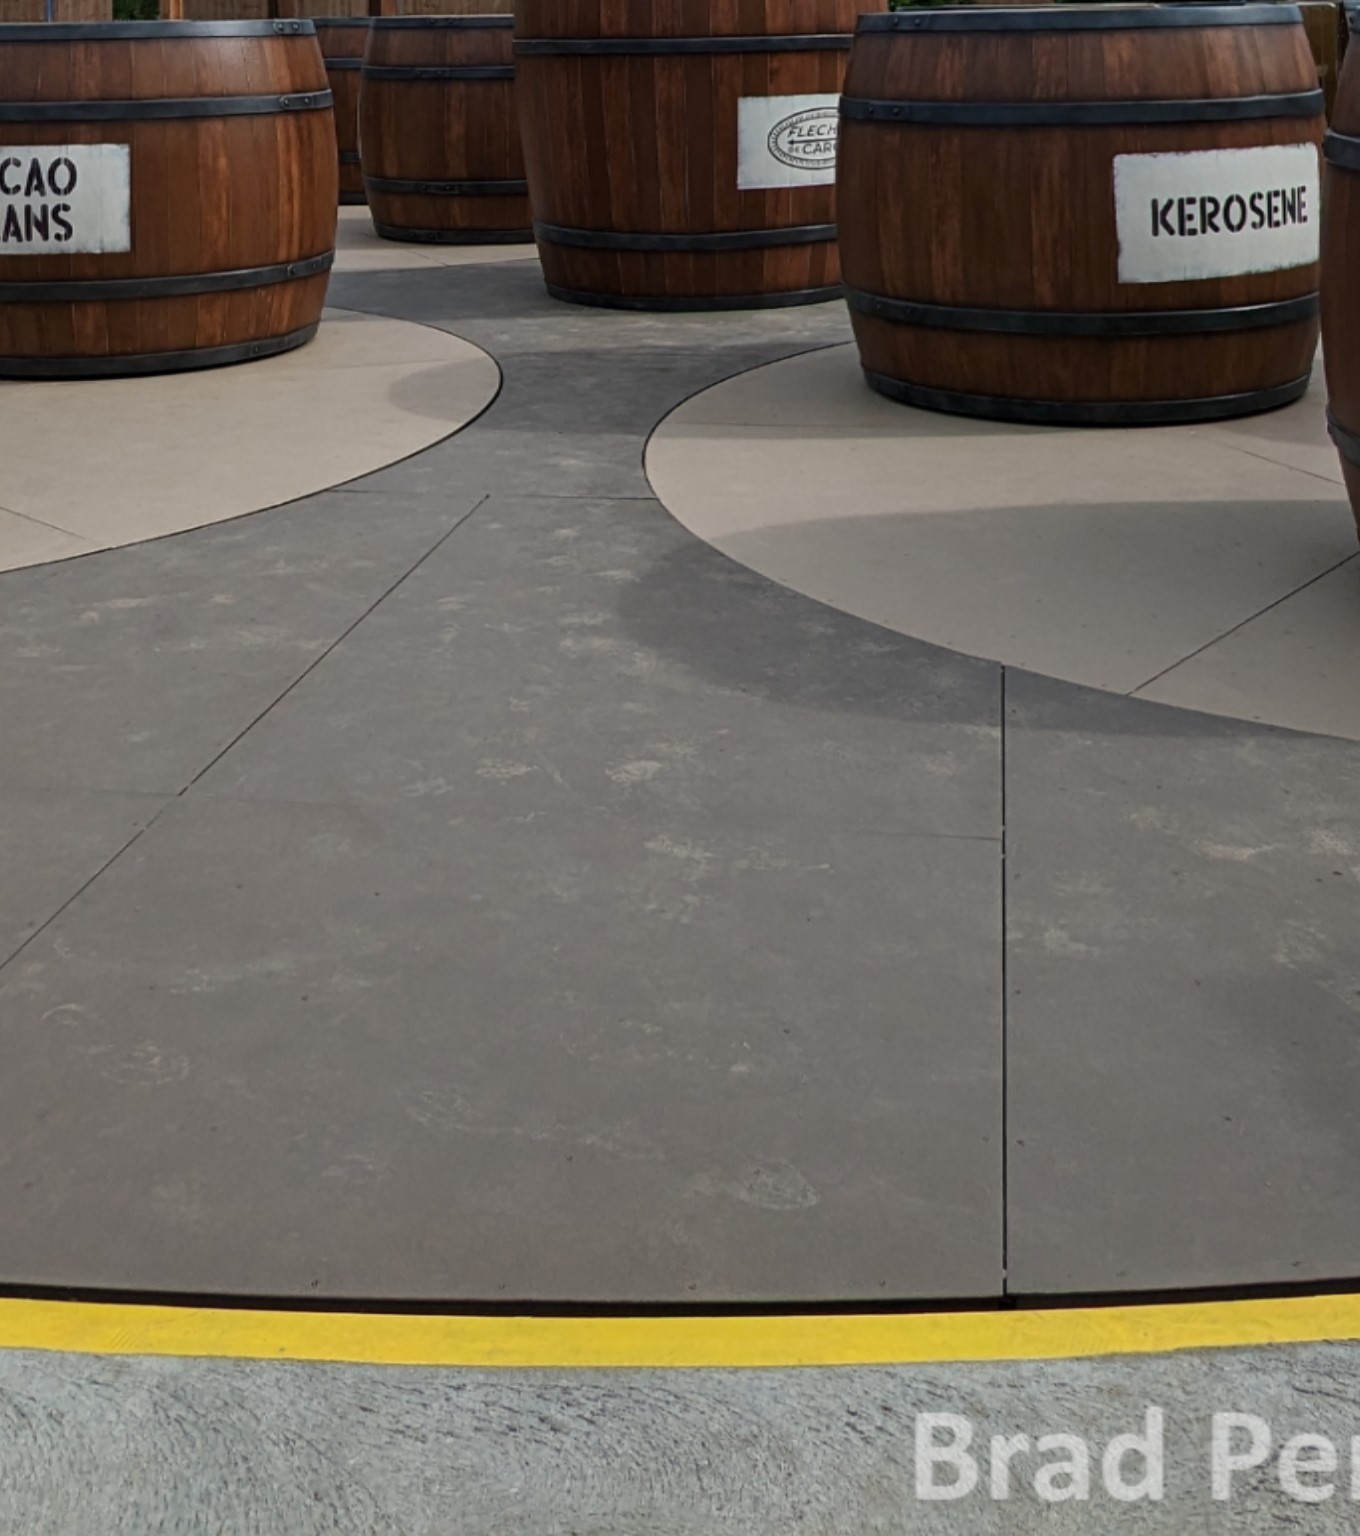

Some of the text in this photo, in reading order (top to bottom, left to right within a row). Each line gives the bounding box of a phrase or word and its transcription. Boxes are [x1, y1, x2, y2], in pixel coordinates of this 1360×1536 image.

[787, 124, 837, 138] FLECH
[803, 141, 837, 155] CAR
[1151, 185, 1308, 237] KEROSENE
